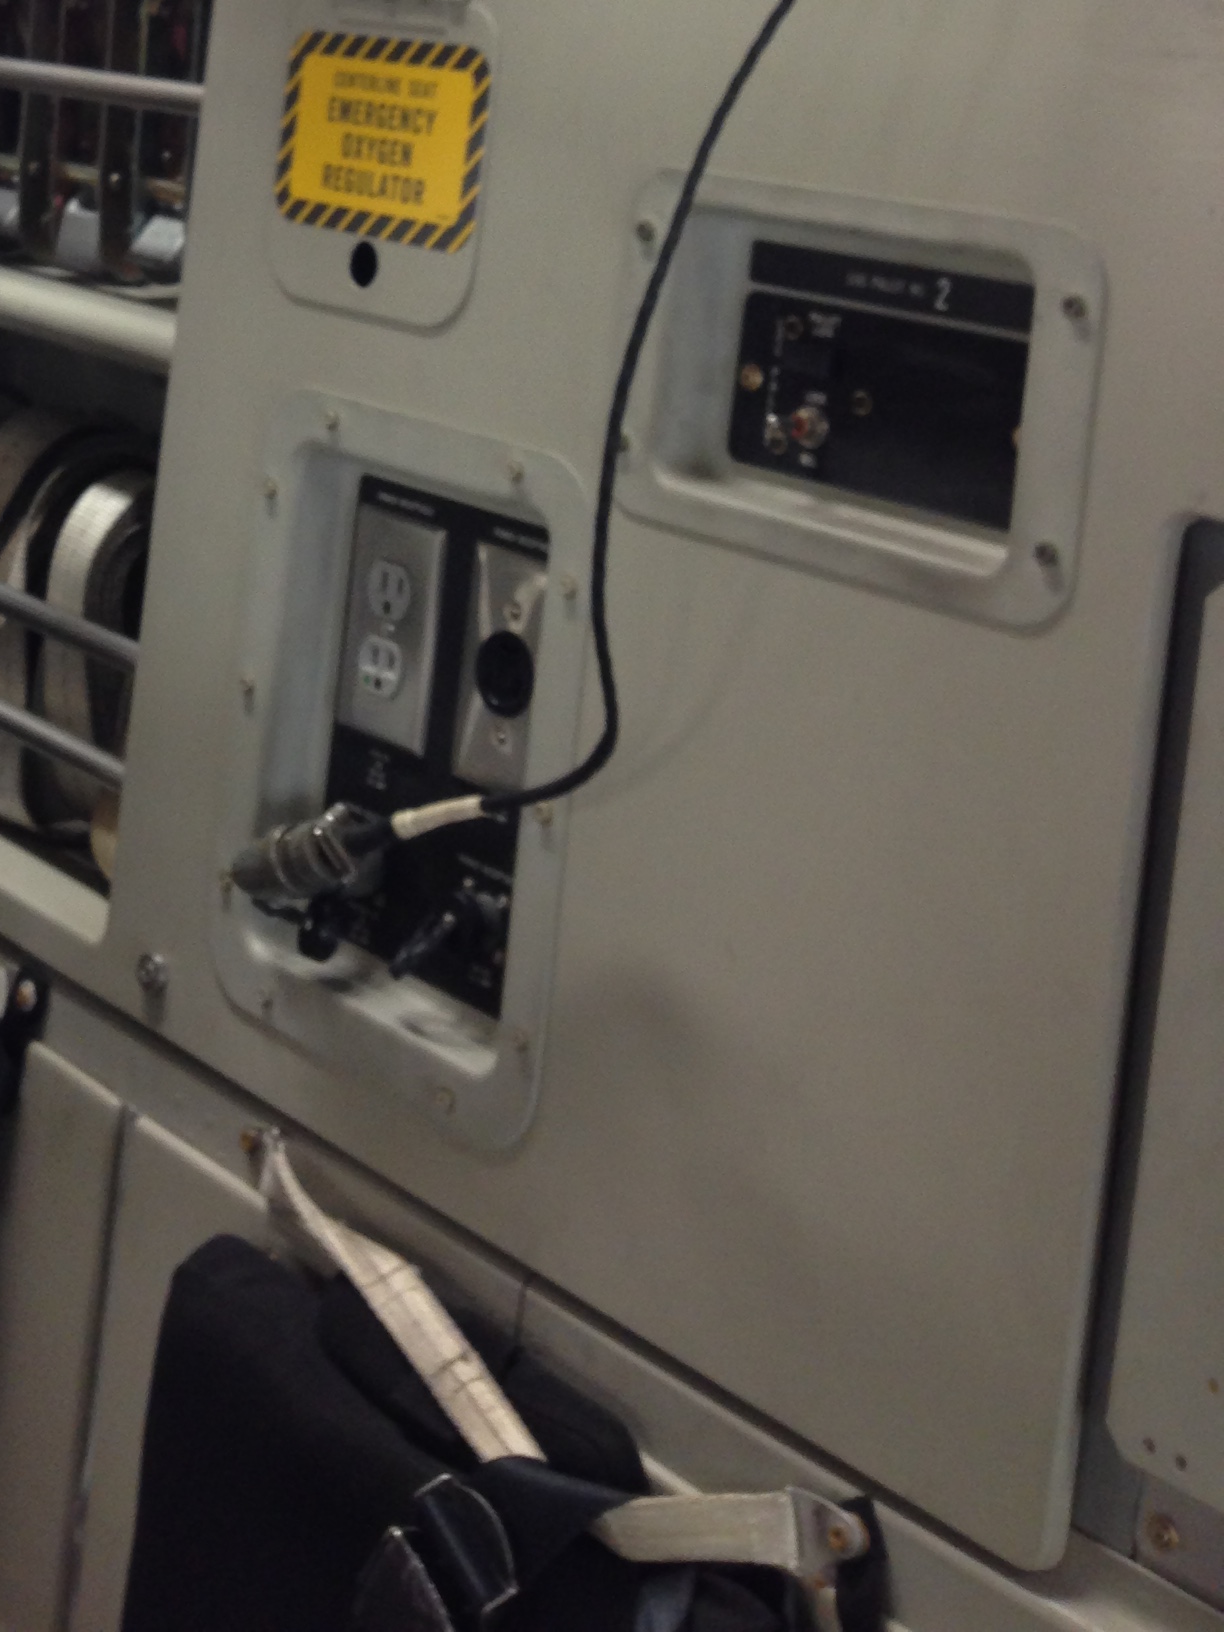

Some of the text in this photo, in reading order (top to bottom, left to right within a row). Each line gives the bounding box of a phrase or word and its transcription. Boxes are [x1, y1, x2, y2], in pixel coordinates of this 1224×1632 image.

[326, 95, 438, 137] EMERGENCY
[340, 131, 415, 169] OXYGEN
[320, 161, 426, 206] REGULATOR
[934, 277, 952, 311] 2
